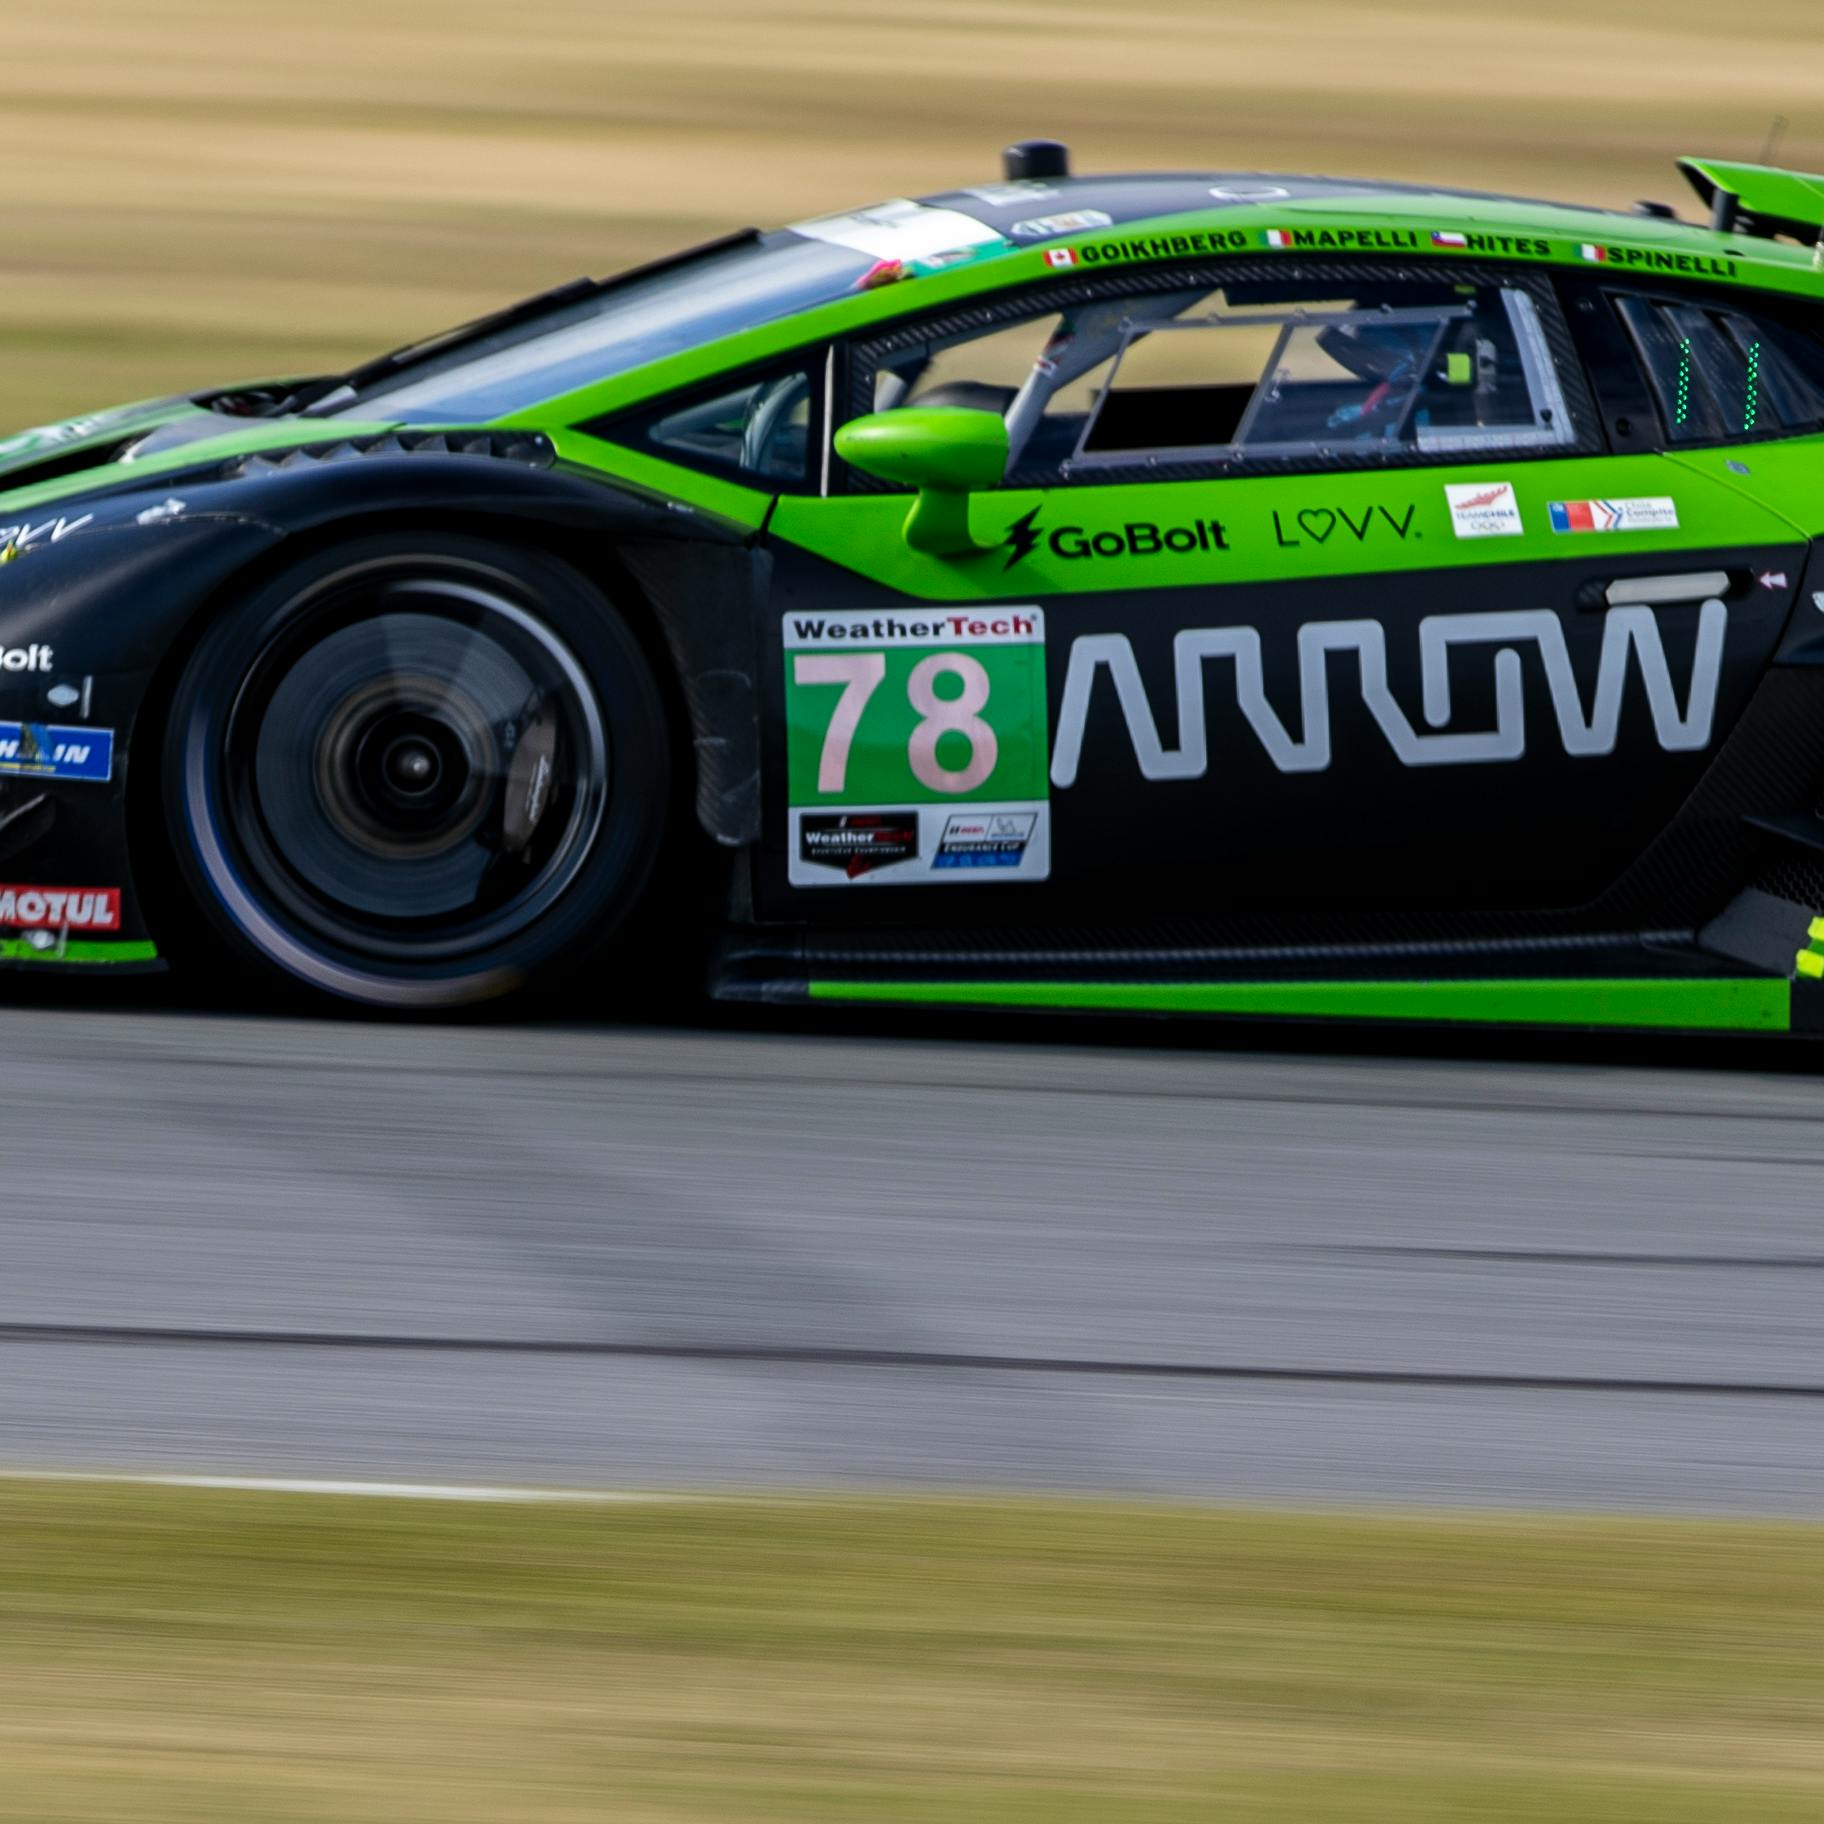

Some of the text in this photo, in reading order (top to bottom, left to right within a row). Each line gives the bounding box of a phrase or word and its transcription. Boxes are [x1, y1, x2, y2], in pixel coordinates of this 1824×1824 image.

[1081, 230, 1247, 262] GOIKHBERG
[1290, 229, 1418, 250] MAPELLI
[1466, 233, 1551, 257] HITES
[1607, 248, 1737, 277] SPINELLI
[1049, 517, 1230, 560] GoBolt
[793, 614, 1034, 640] WeatherTech
[1050, 598, 1728, 789] ARROW
[793, 652, 999, 795] 78
